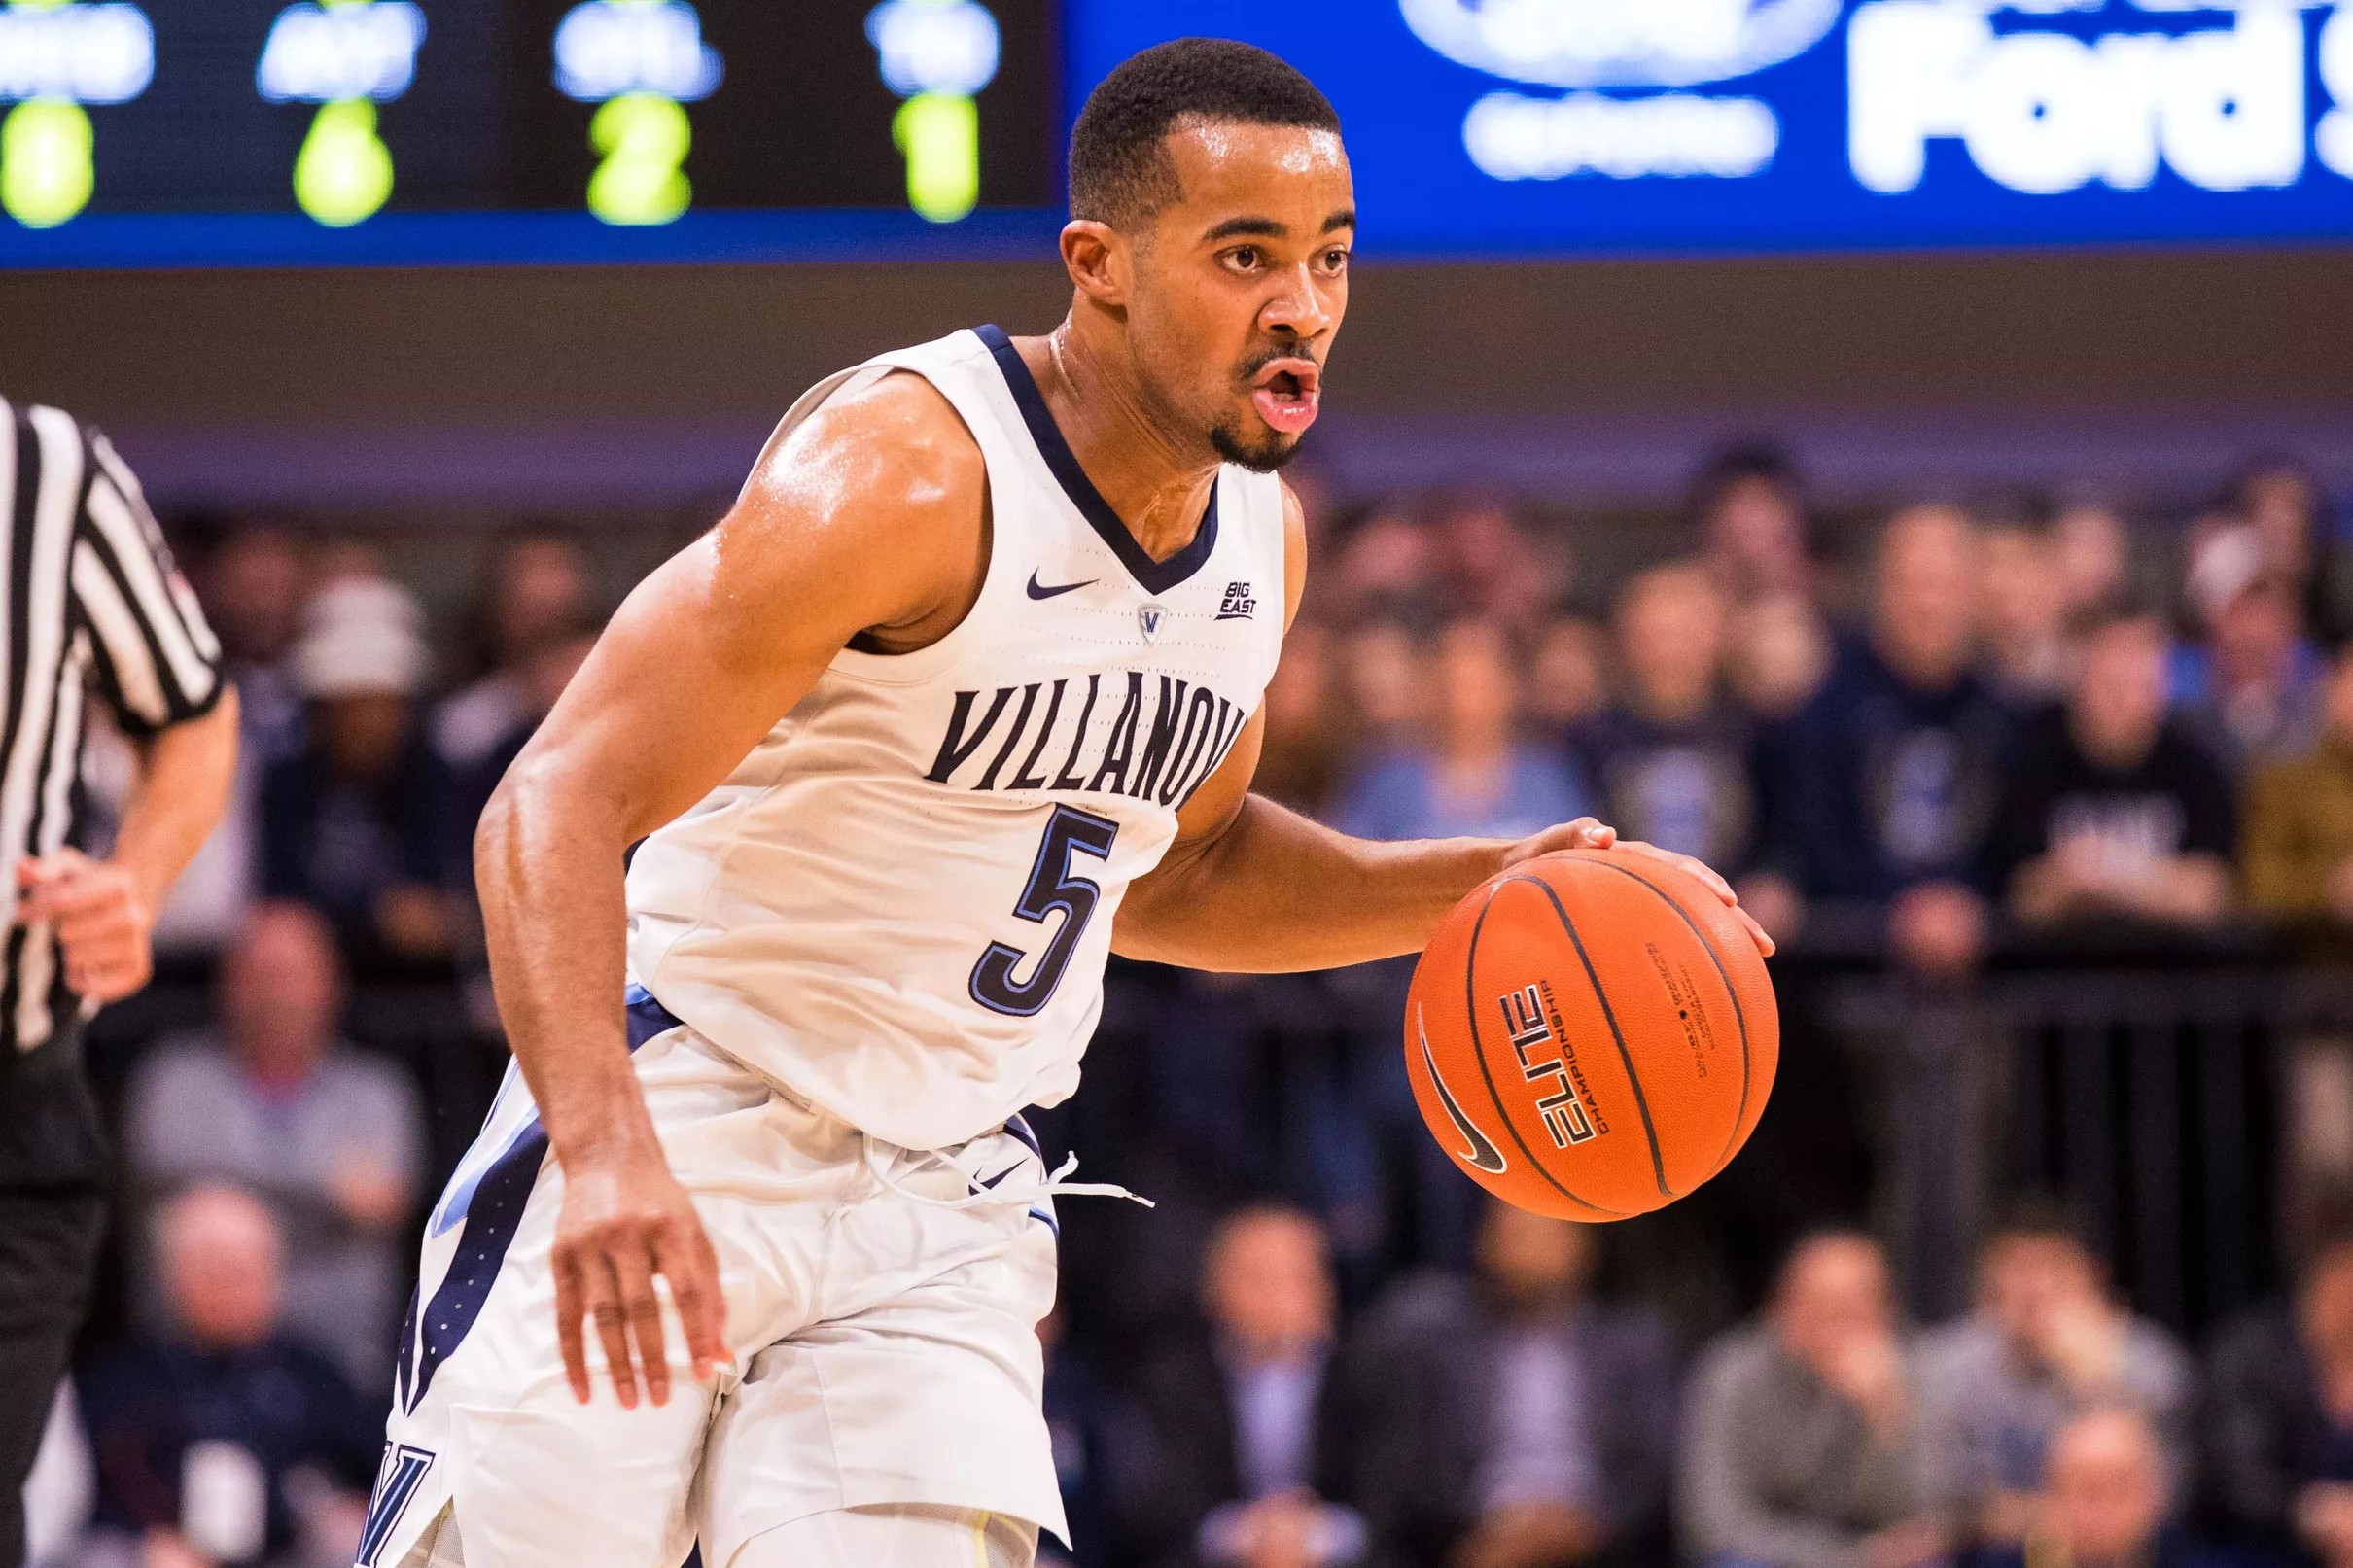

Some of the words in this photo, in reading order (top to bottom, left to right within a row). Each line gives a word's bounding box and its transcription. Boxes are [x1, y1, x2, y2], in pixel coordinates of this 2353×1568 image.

[587, 92, 692, 226] 2
[1847, 2, 2305, 193] Ford
[1144, 611, 1160, 634] V
[1219, 598, 1257, 614] EAST
[1224, 581, 1251, 598] BIG
[923, 671, 1248, 813] VILLANOV
[968, 802, 1120, 1018] 5
[1498, 984, 1597, 1149] ELITE
[1540, 979, 1610, 1136] CHAMPIONSHIP
